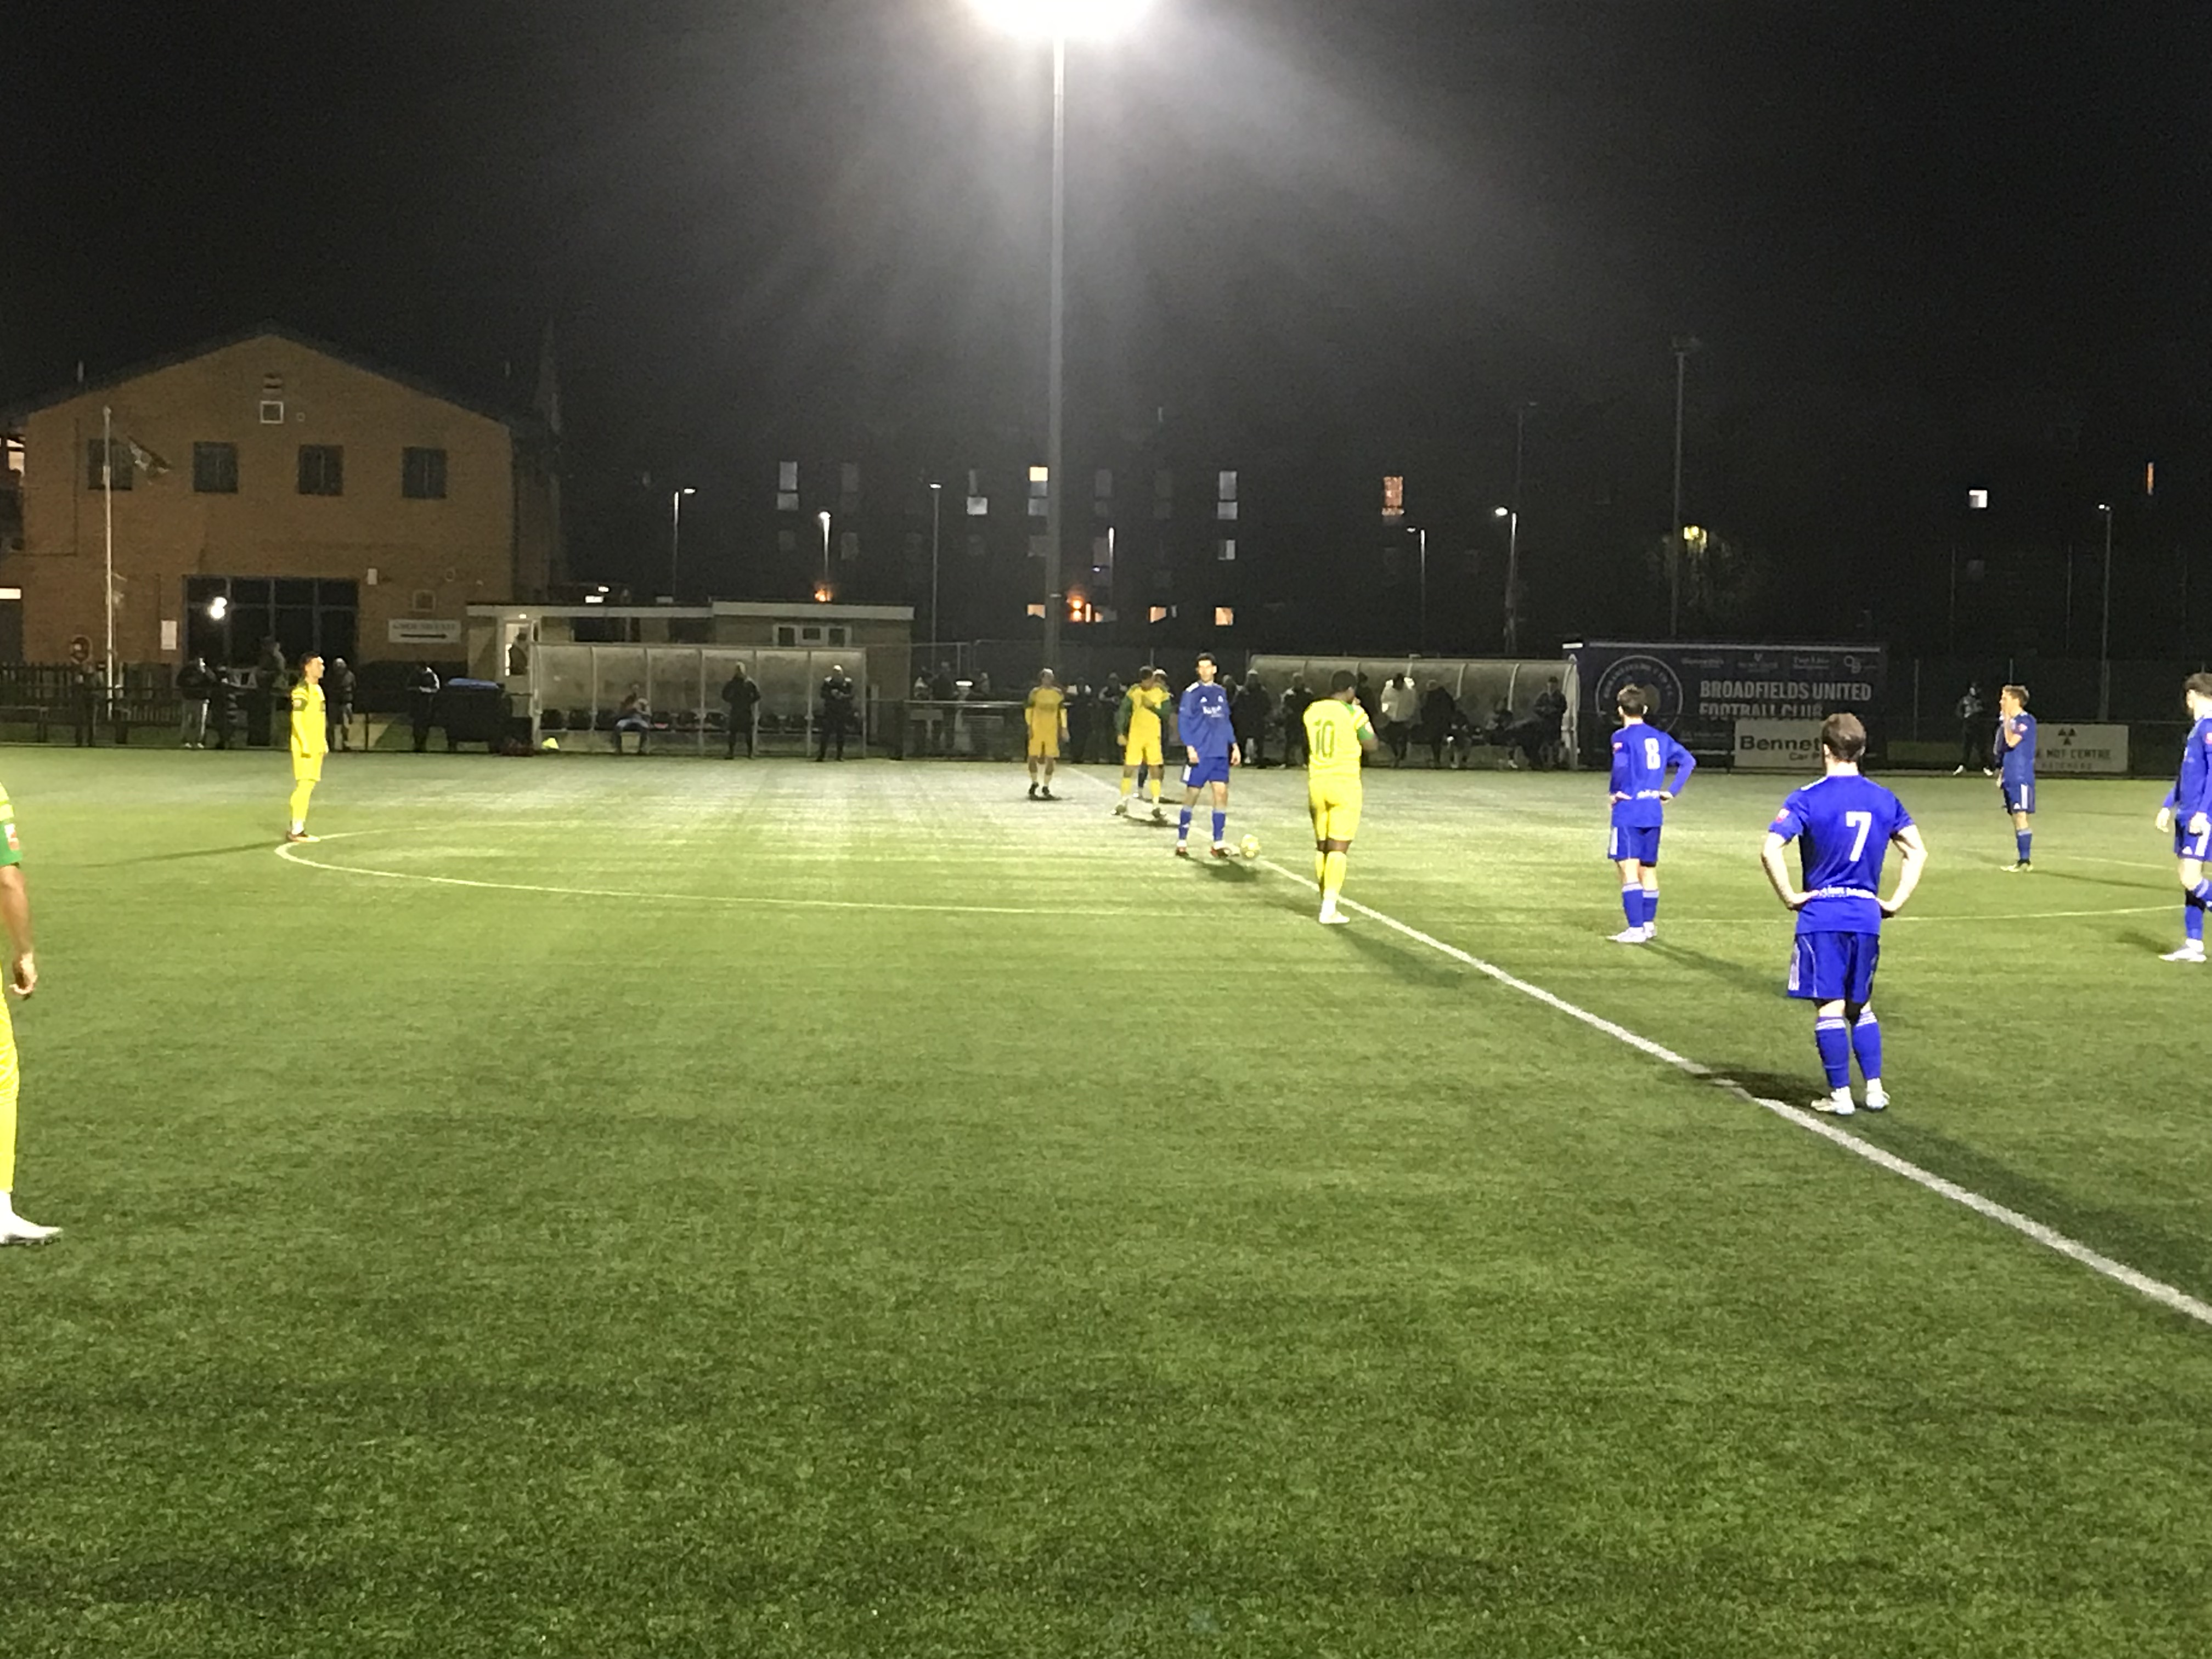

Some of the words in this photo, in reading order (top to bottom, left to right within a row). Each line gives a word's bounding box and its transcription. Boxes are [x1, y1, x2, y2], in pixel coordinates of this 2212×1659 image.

[1700, 680, 1809, 699] BROADFIELDS
[1812, 682, 1872, 701] UNITED
[1699, 702, 1776, 720] FOOTBALL
[1314, 719, 1334, 758] 10
[1740, 735, 1820, 751] Bennet
[1644, 737, 1661, 770] 8
[1846, 811, 1872, 862] 7
